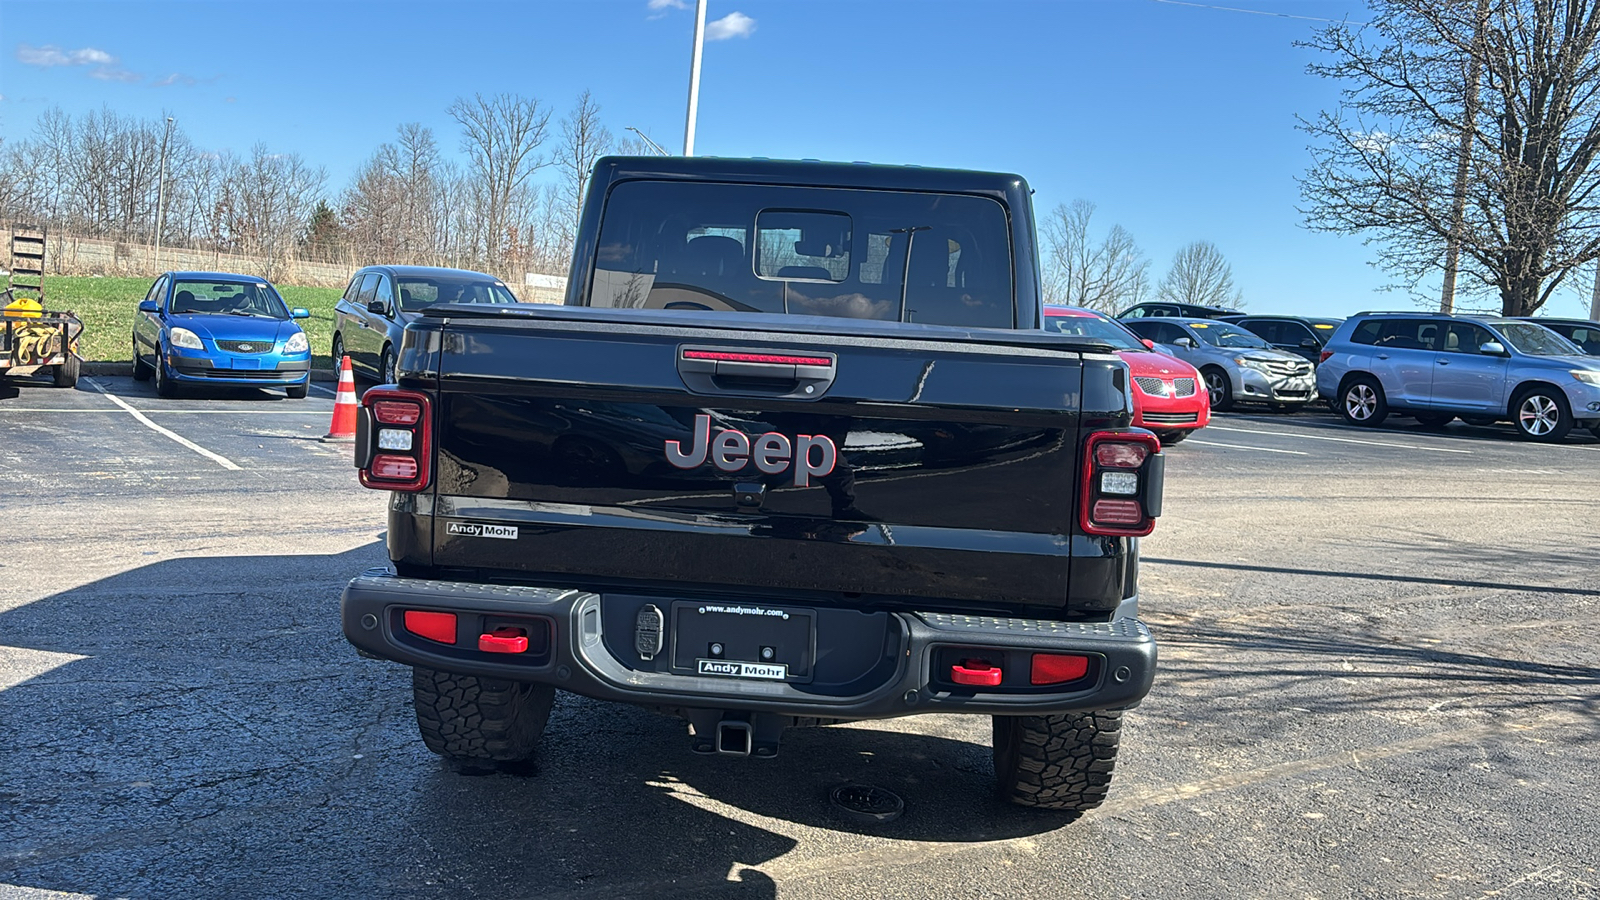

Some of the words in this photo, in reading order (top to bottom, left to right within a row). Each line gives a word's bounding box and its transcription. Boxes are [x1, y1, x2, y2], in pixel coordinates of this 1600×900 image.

[665, 414, 837, 487] Jeep
[449, 523, 481, 535] Andy
[485, 526, 516, 536] Mohr
[705, 605, 783, 616] www.andymohr.com
[703, 662, 739, 673] Andy
[744, 666, 782, 677] Mohr
